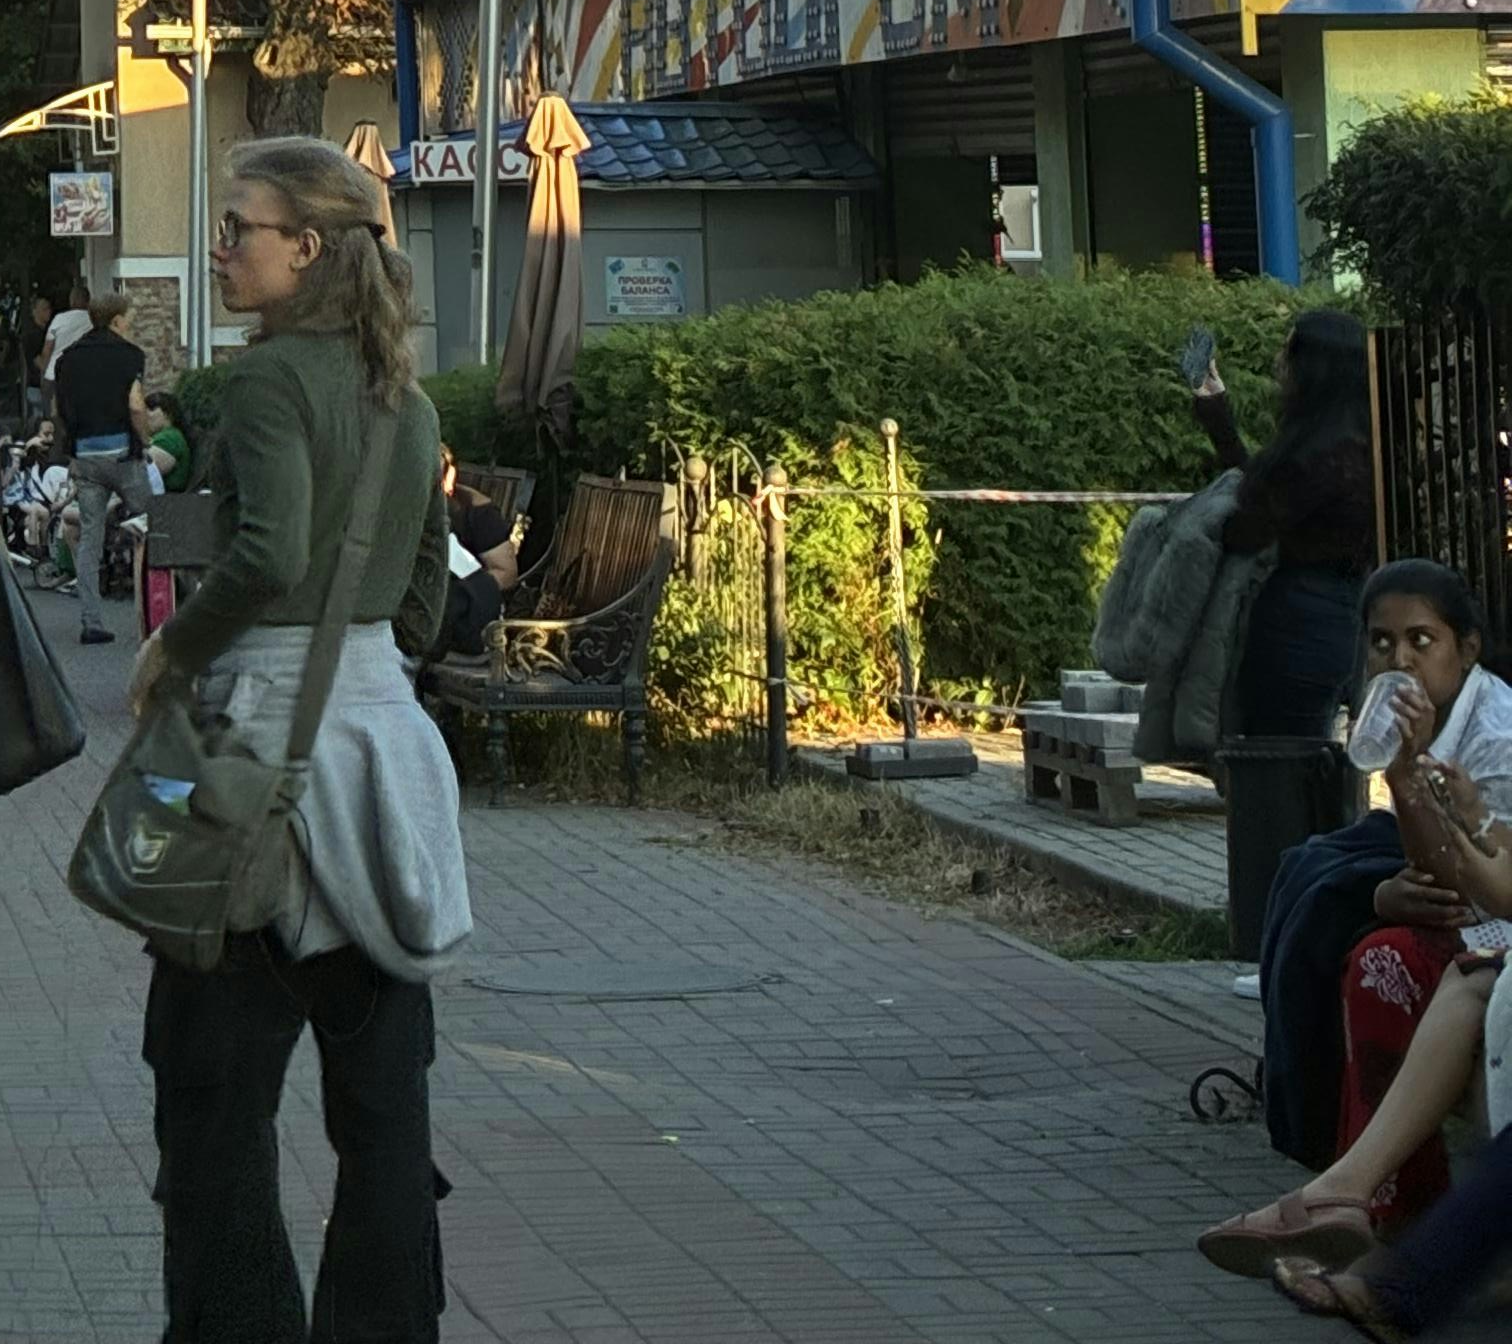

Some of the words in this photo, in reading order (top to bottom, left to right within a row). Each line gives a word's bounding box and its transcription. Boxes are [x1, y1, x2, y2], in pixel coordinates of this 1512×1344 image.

[413, 143, 531, 178] КАС
[618, 276, 673, 285] ПРОВЕРКА
[621, 286, 670, 295] БАЛАНСА
